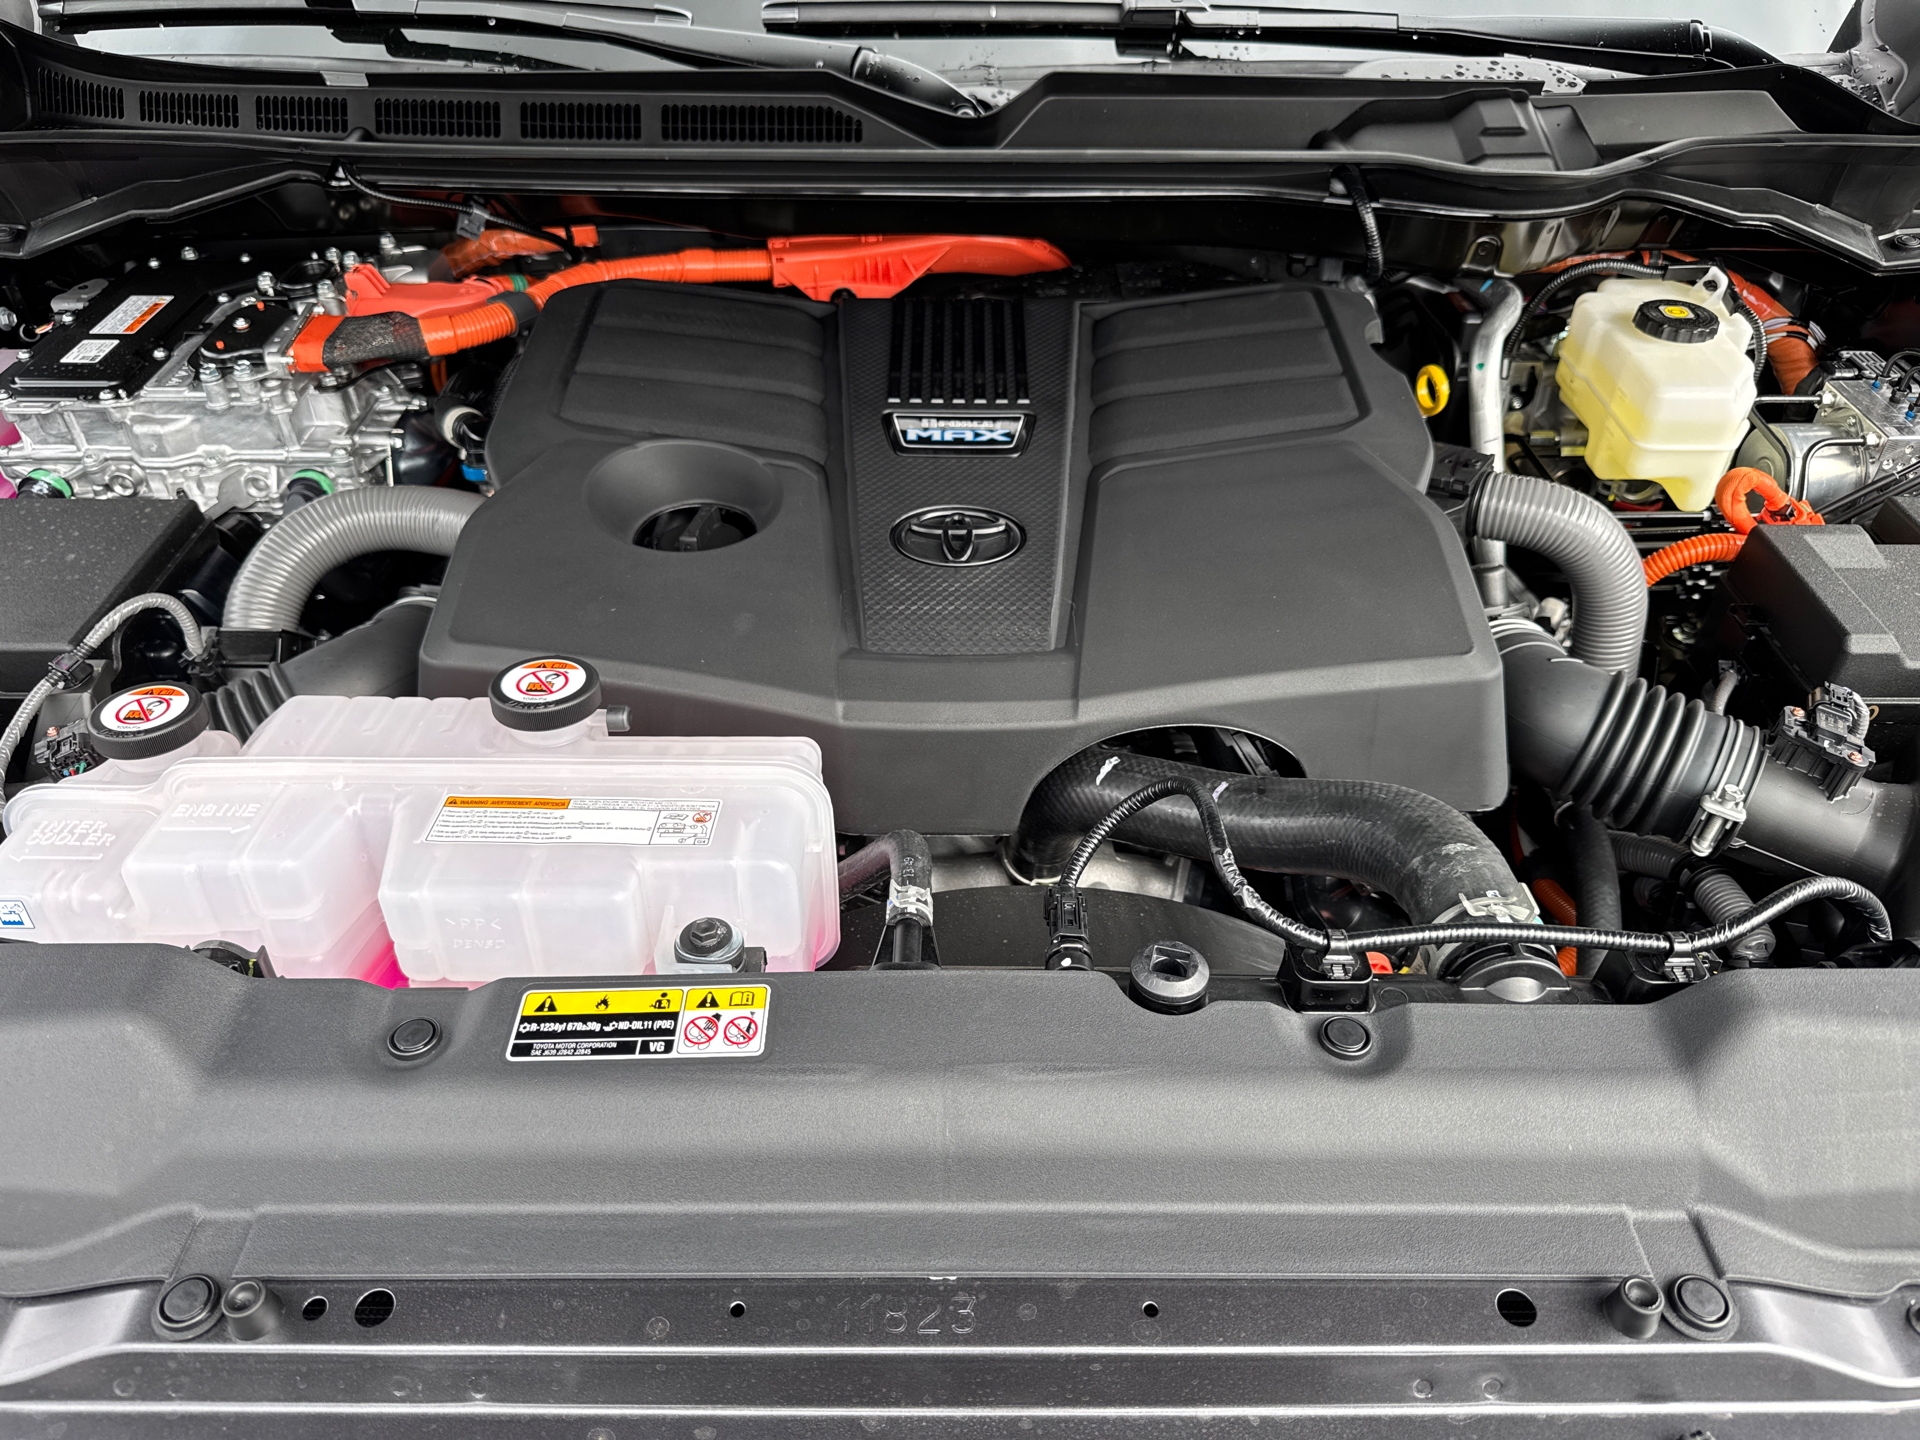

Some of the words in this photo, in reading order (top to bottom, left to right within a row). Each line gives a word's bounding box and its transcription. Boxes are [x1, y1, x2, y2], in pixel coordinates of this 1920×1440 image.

[906, 429, 1011, 441] MAX
[170, 804, 262, 817] ENGINE
[33, 820, 108, 833] INTER
[653, 1019, 675, 1031] (POE)
[649, 1041, 666, 1052] VG
[837, 1296, 977, 1334] 11823
